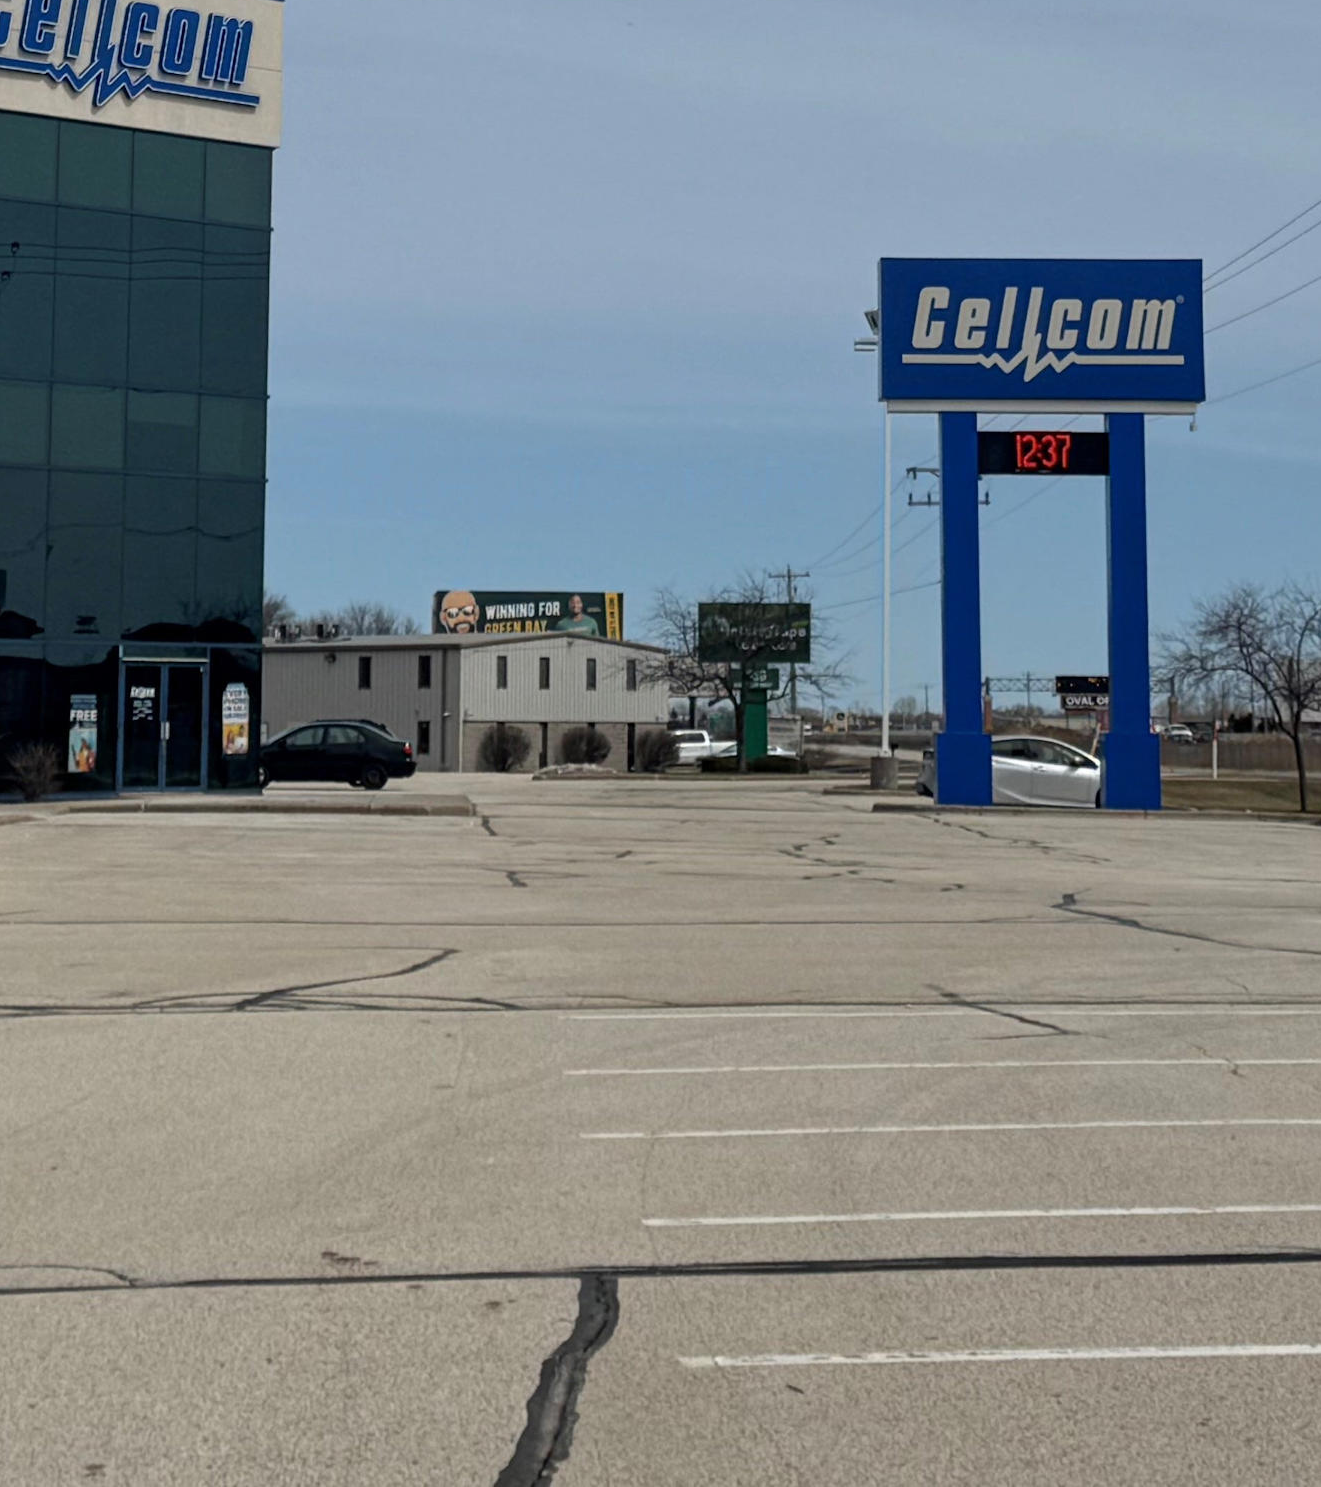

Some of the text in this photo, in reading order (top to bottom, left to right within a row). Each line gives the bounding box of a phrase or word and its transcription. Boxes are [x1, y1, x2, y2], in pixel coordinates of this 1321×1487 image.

[910, 286, 1177, 381] Cellcom
[1016, 434, 1070, 468] 12:37
[485, 601, 560, 620] WINNING FOR
[484, 620, 549, 634] GREEN BAY
[1065, 696, 1095, 706] OVAL
[69, 709, 98, 723] FREE
